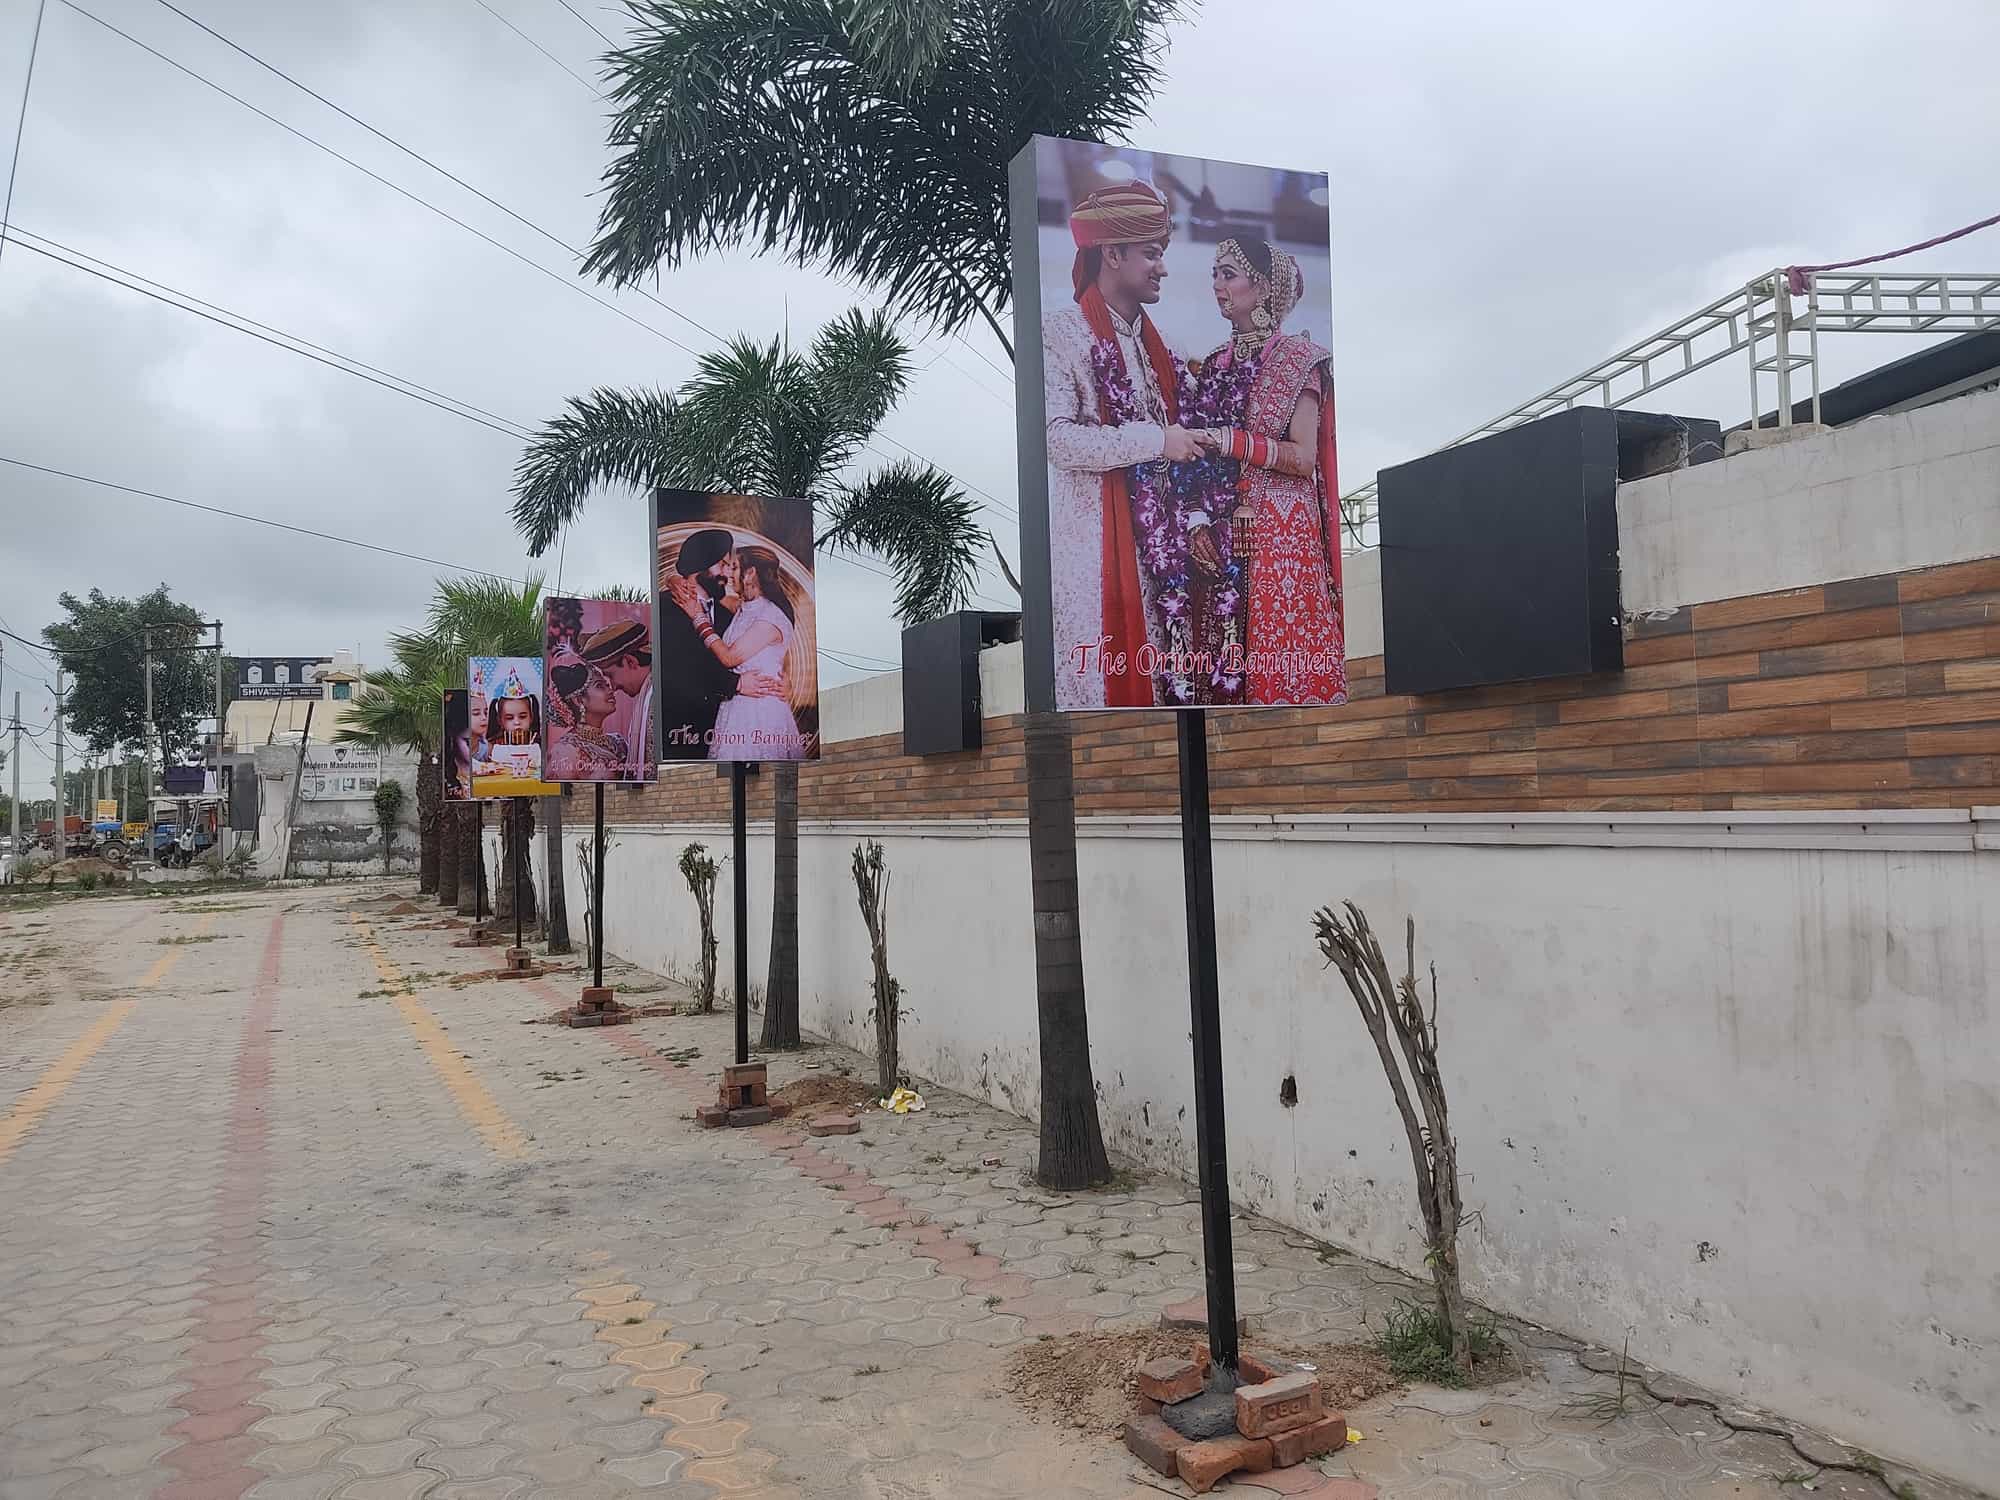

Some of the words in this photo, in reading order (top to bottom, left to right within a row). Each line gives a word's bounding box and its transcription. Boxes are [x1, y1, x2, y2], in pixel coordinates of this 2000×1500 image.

[1070, 635, 1128, 676] The
[1135, 643, 1213, 675] Orion
[1220, 643, 1338, 690] Banquet
[242, 687, 270, 696] SHIVA
[668, 723, 700, 745] The
[703, 728, 746, 745] Orion
[751, 728, 814, 751] Banquet
[329, 761, 377, 769] Manufacturers
